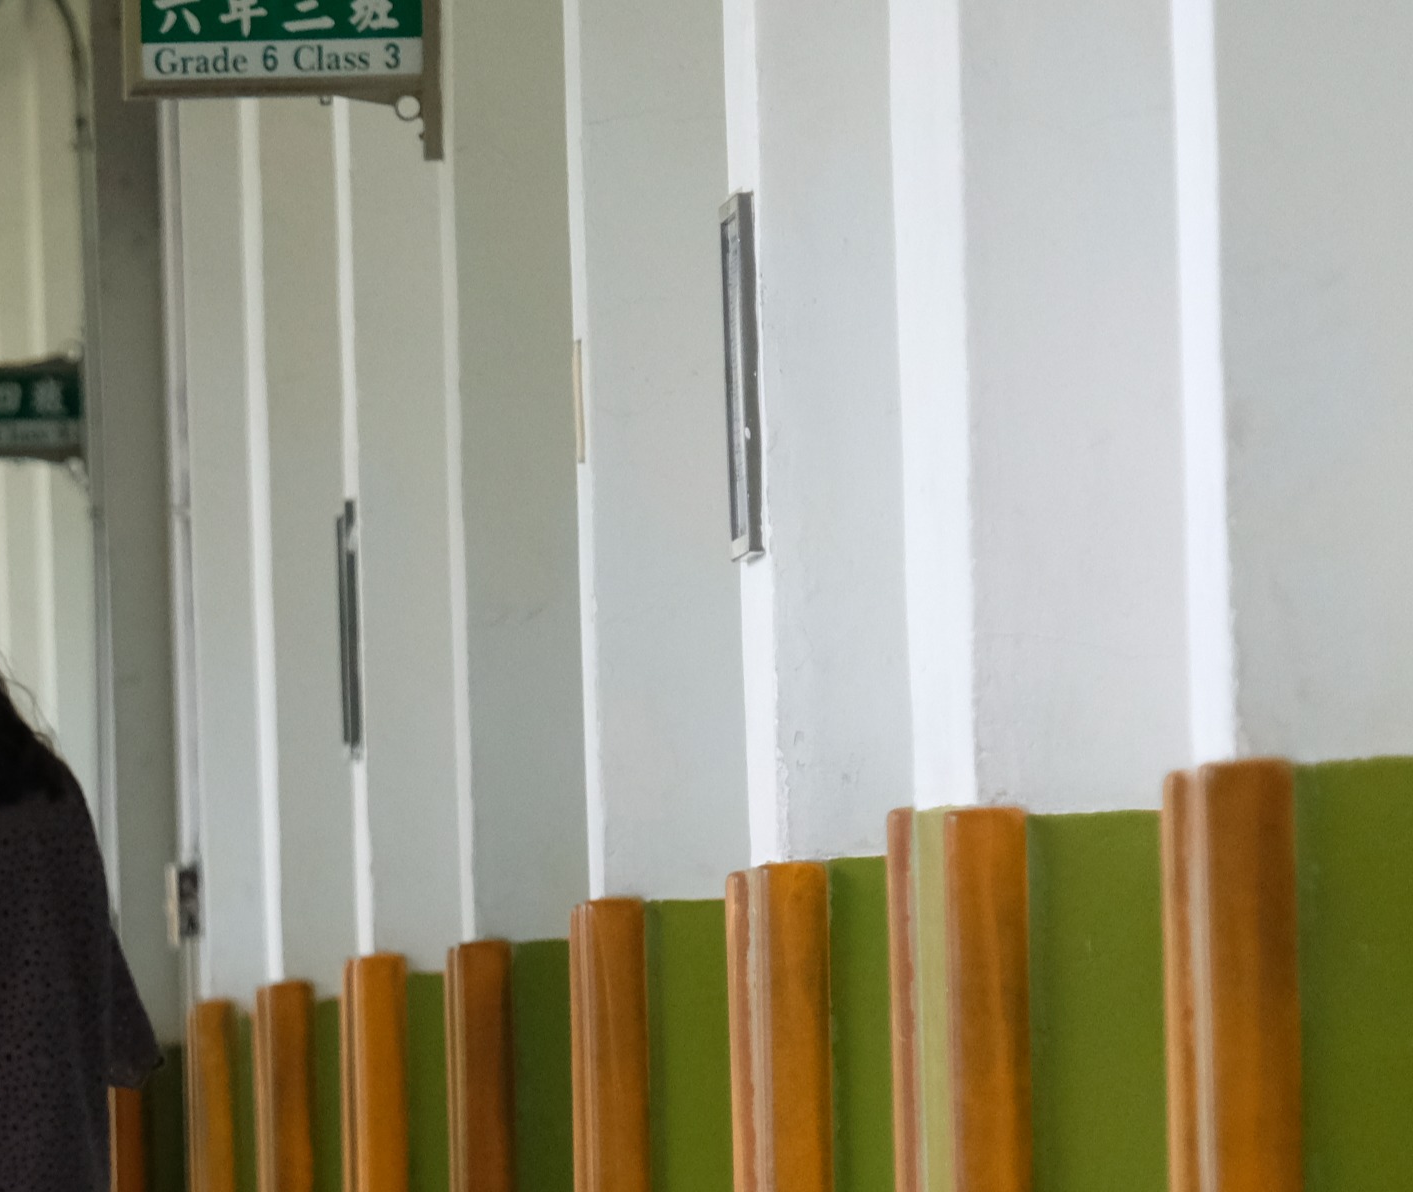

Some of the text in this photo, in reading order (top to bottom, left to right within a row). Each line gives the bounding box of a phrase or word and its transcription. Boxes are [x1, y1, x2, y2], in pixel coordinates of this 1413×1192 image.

[154, 43, 401, 75] Grade 6 Class 3
